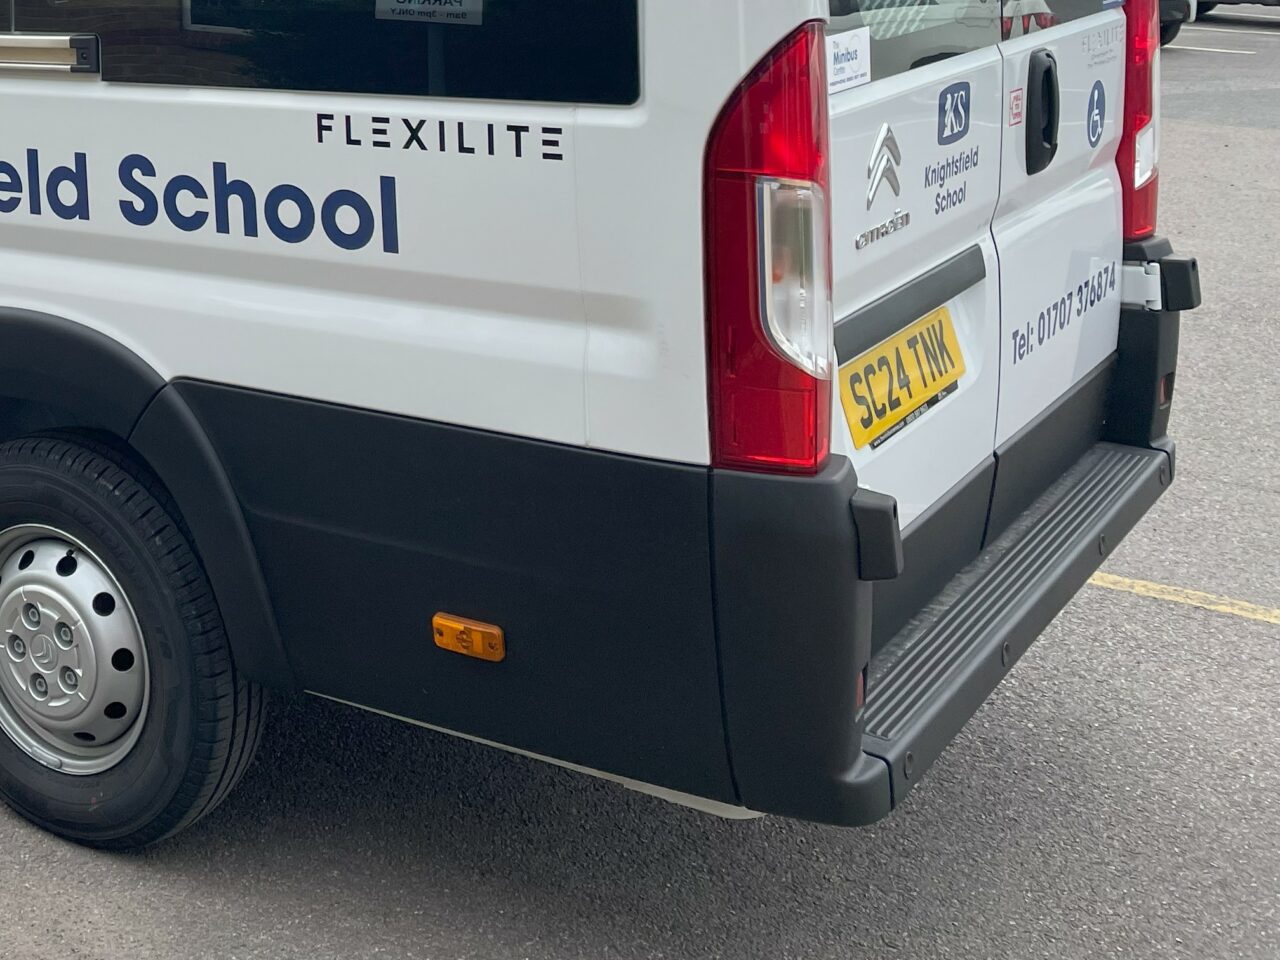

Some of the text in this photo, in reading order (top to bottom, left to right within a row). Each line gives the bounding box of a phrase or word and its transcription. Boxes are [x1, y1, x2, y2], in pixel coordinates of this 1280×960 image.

[833, 47, 858, 65] Minibus
[317, 113, 563, 161] FLEXILITE
[943, 90, 966, 137] KS
[924, 145, 979, 189] Knightsfield
[118, 154, 399, 254] School
[935, 180, 967, 215] School
[1012, 261, 1116, 365] Tel: 01707 376874
[849, 347, 914, 430] SC24
[908, 320, 956, 389] TNK
